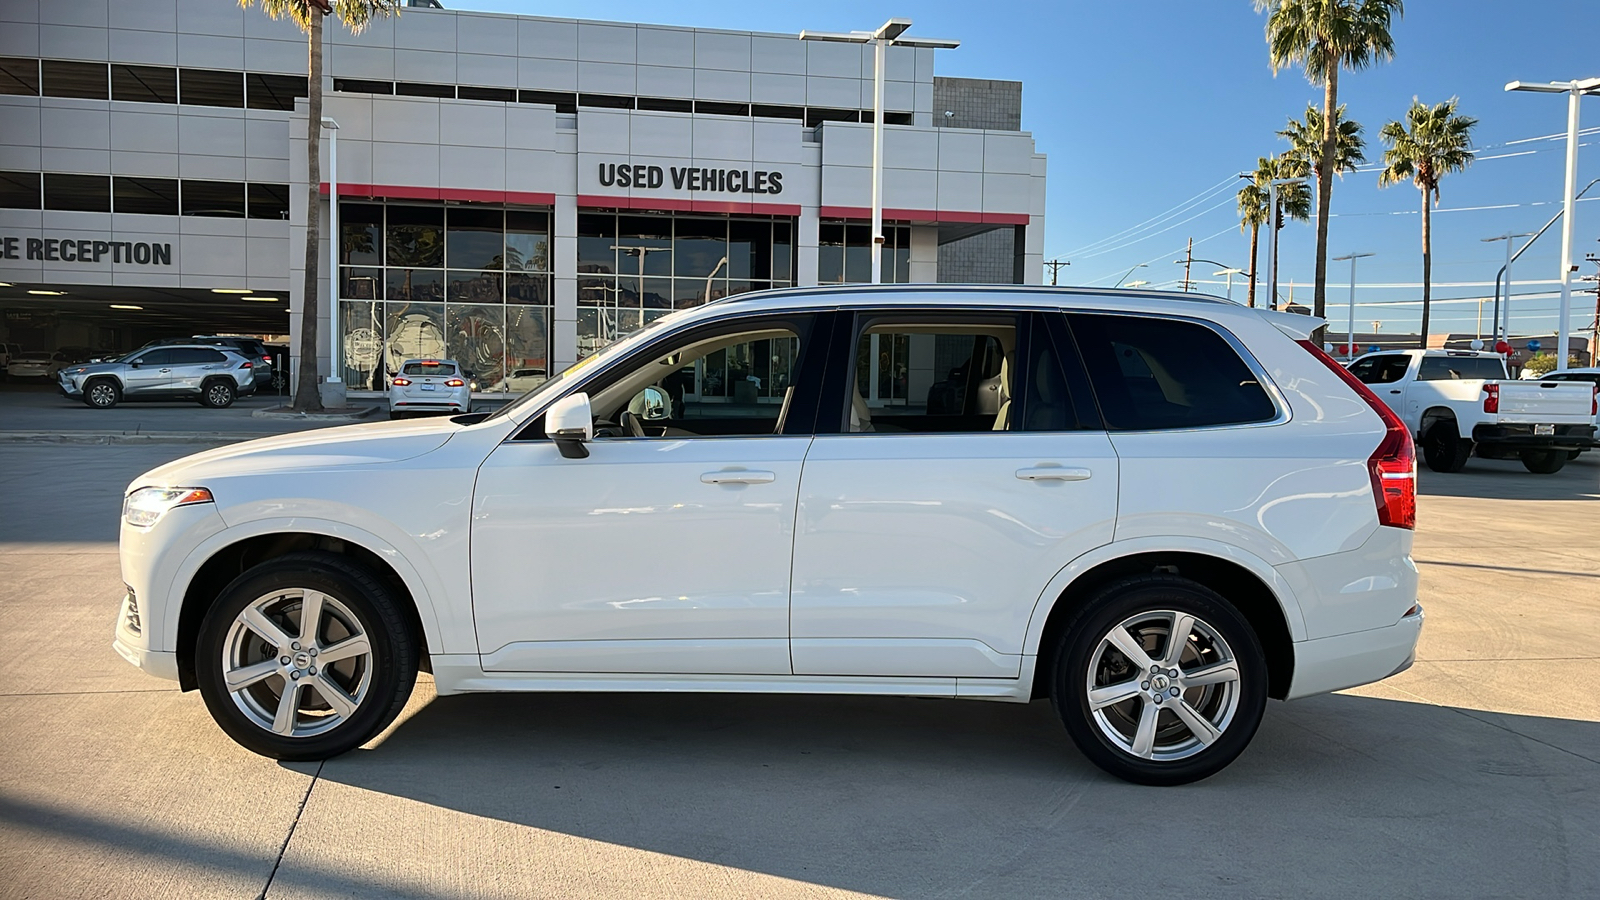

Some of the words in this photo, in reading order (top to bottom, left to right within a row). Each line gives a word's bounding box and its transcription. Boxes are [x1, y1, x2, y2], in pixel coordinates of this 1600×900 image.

[599, 163, 663, 189] USED
[670, 166, 783, 195] VEHICLES
[0, 237, 20, 260] E
[26, 238, 171, 266] RECEPTION
